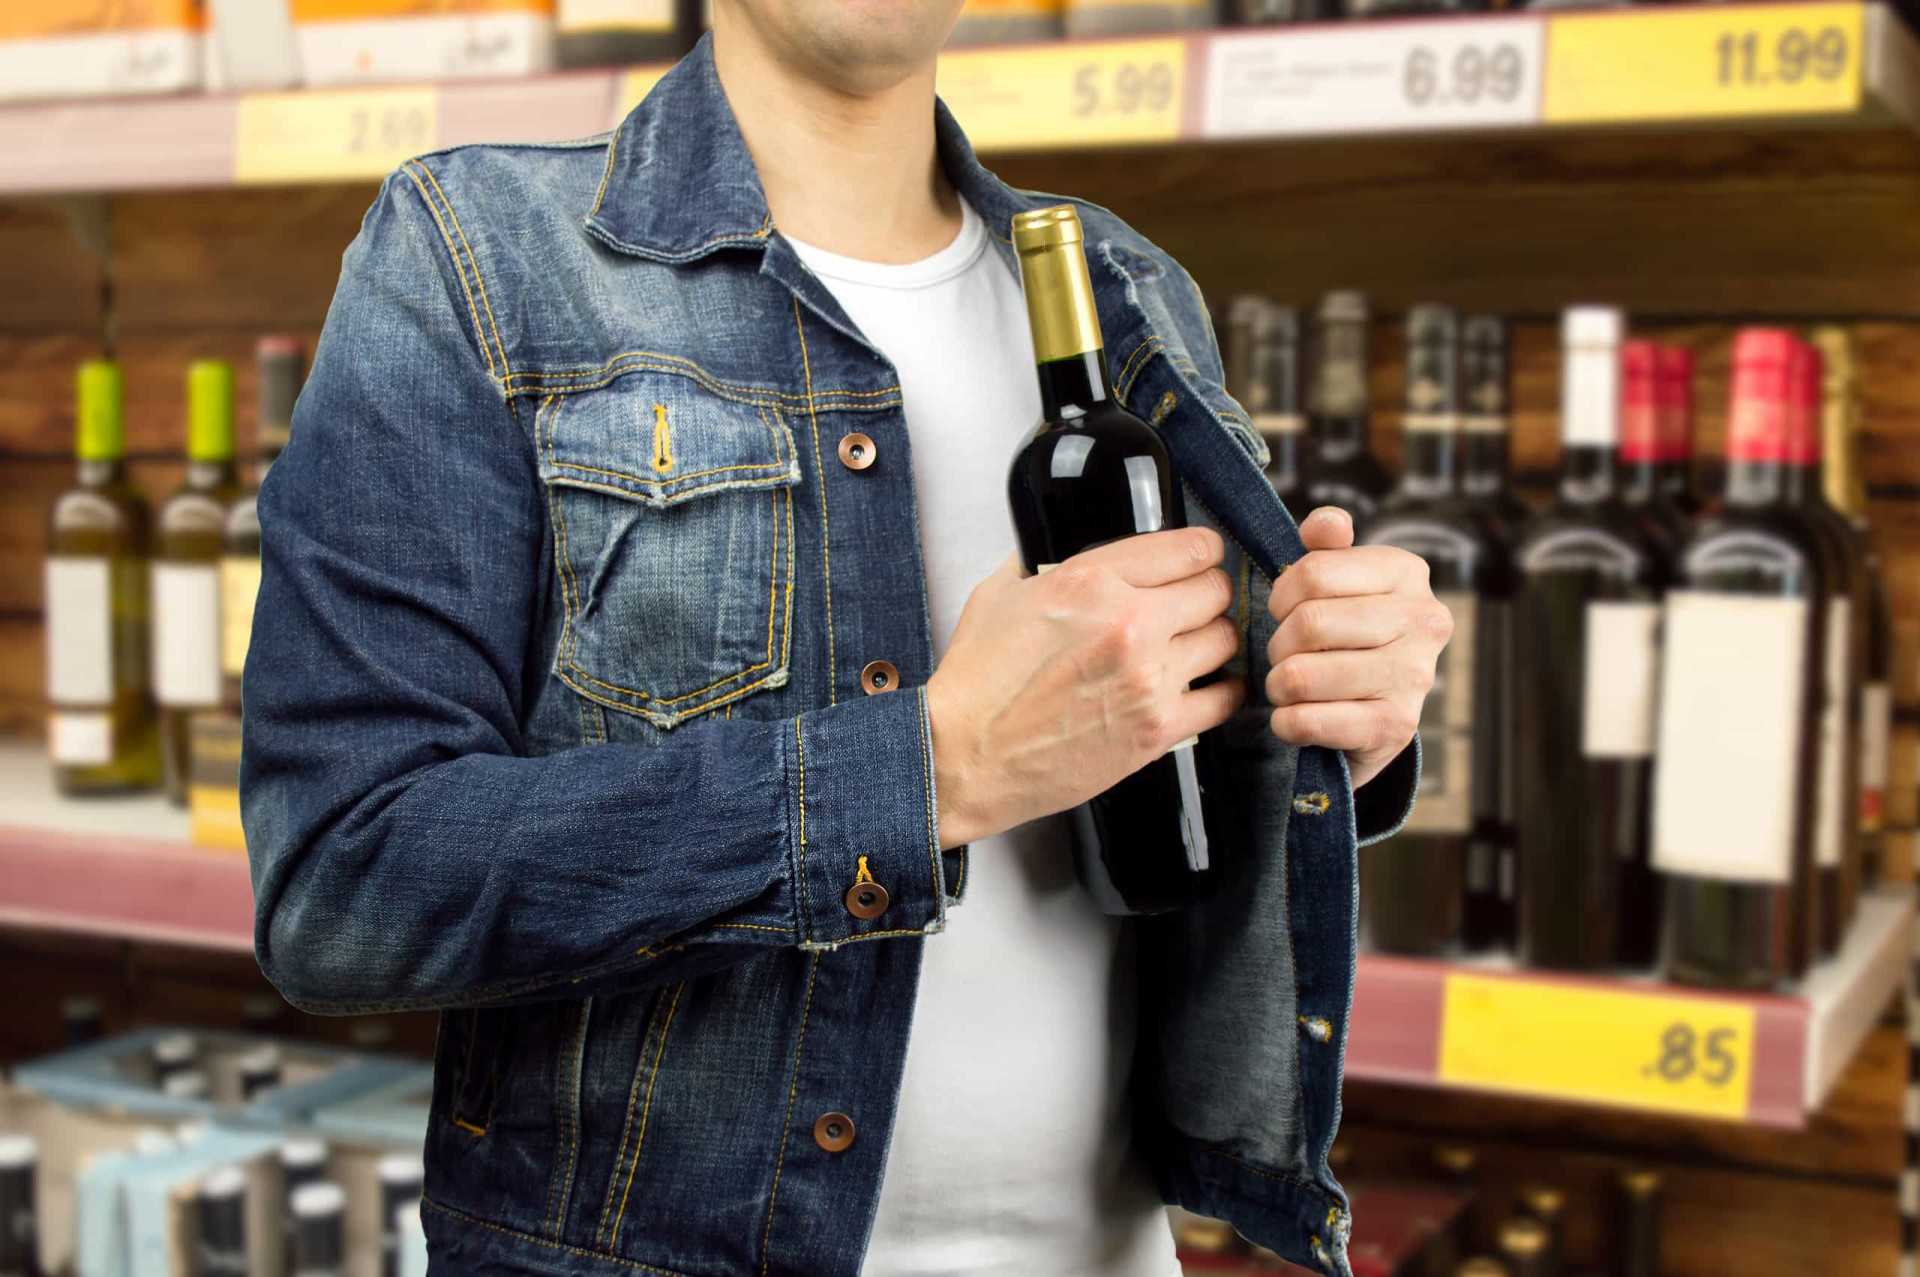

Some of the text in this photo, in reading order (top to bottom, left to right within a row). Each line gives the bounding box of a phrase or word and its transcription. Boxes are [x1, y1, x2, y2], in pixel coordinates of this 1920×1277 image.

[1403, 45, 1523, 107] 6.99
[1716, 26, 1847, 86] 11.99
[1074, 61, 1174, 117] 5.99
[1640, 1021, 1738, 1088] .85
